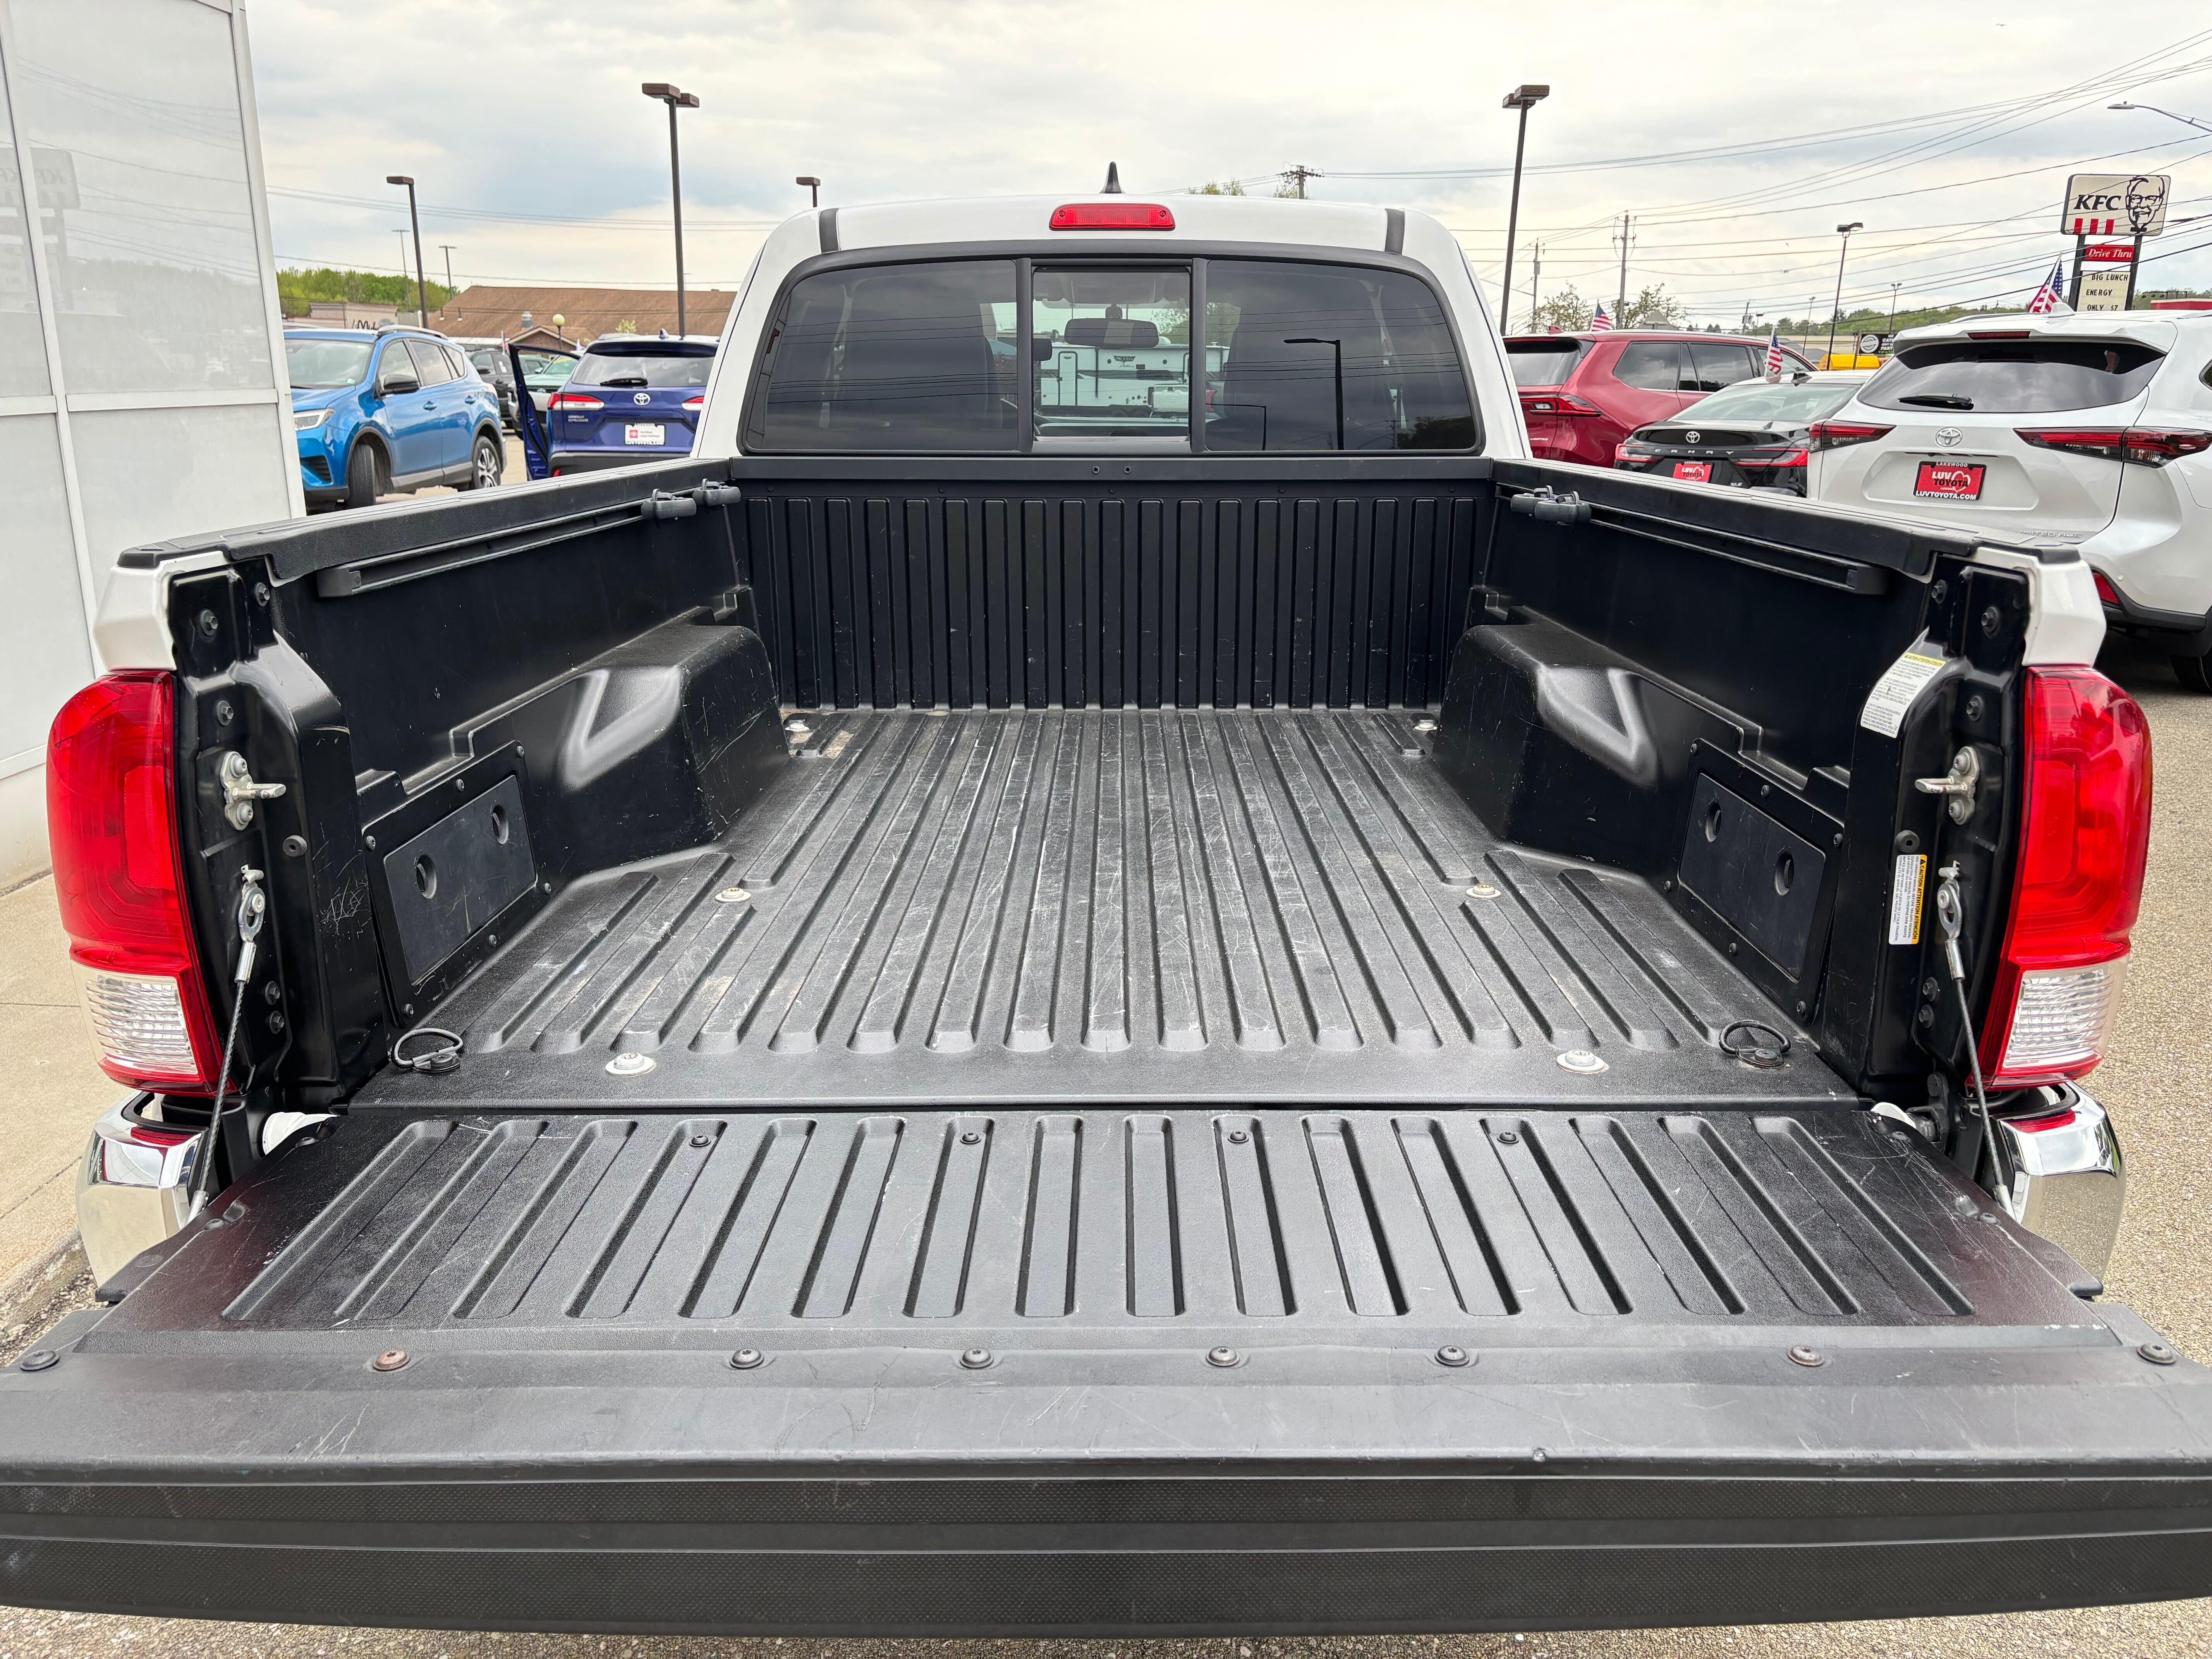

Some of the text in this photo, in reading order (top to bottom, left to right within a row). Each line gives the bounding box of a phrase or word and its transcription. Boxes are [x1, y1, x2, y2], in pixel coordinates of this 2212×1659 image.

[2073, 194, 2121, 211] KFC
[2088, 249, 2132, 258] Drive Thru
[1934, 479, 1968, 487] TOYOTA
[1916, 491, 1976, 500] LUVTOYOTA.COM
